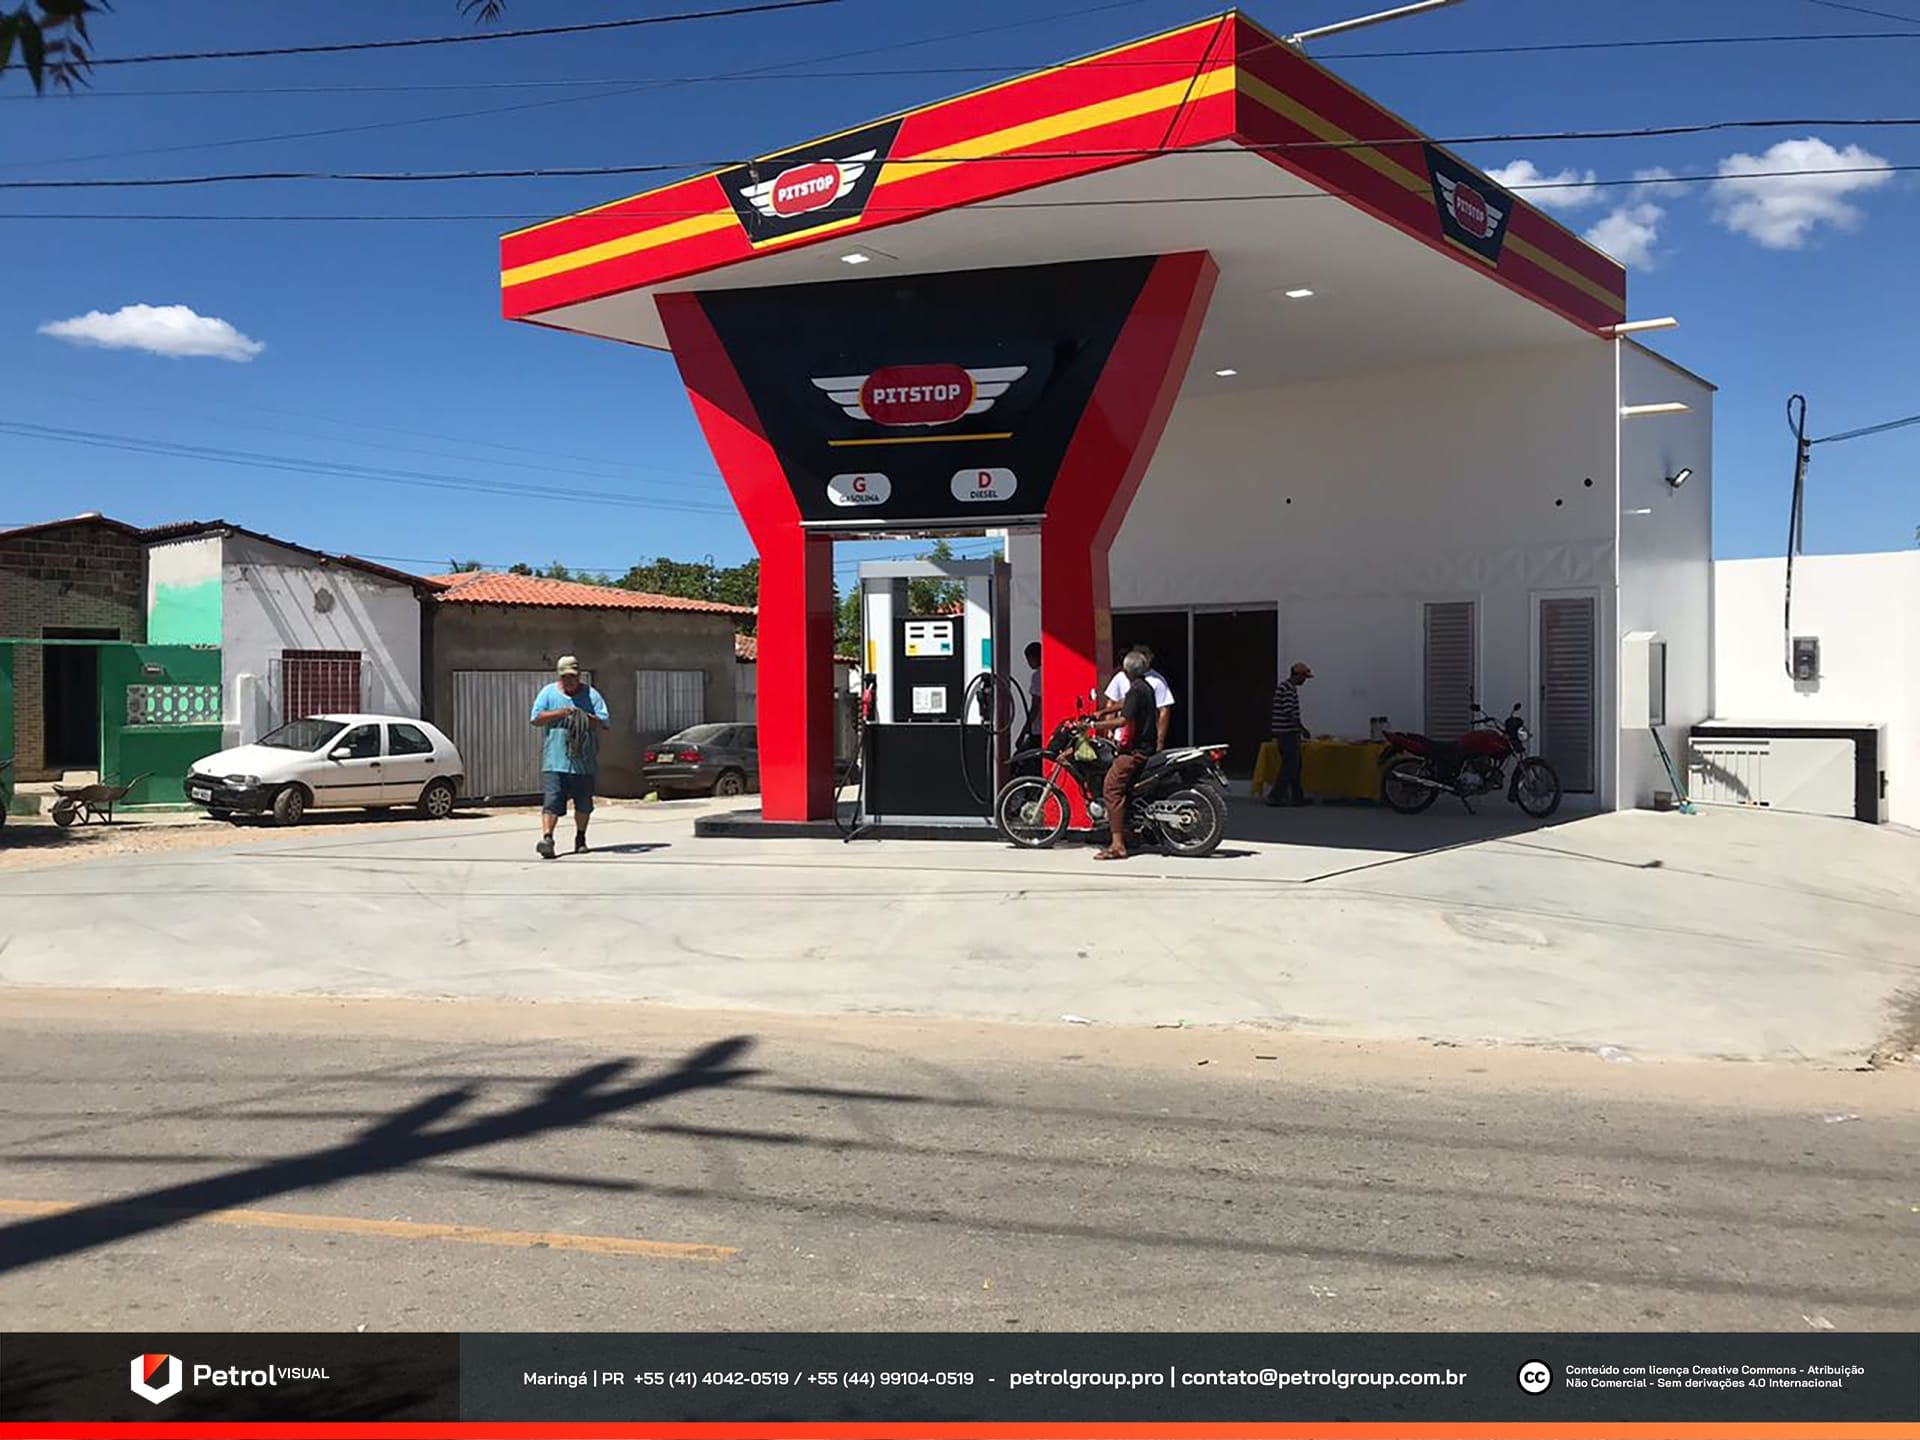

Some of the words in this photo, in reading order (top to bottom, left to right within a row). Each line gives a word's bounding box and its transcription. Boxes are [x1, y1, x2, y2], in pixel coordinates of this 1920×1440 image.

[778, 175, 834, 202] PITSTOP
[873, 384, 961, 404] PITSTOP
[853, 476, 866, 493] G
[978, 471, 992, 489] D
[970, 490, 998, 499] DIESEL
